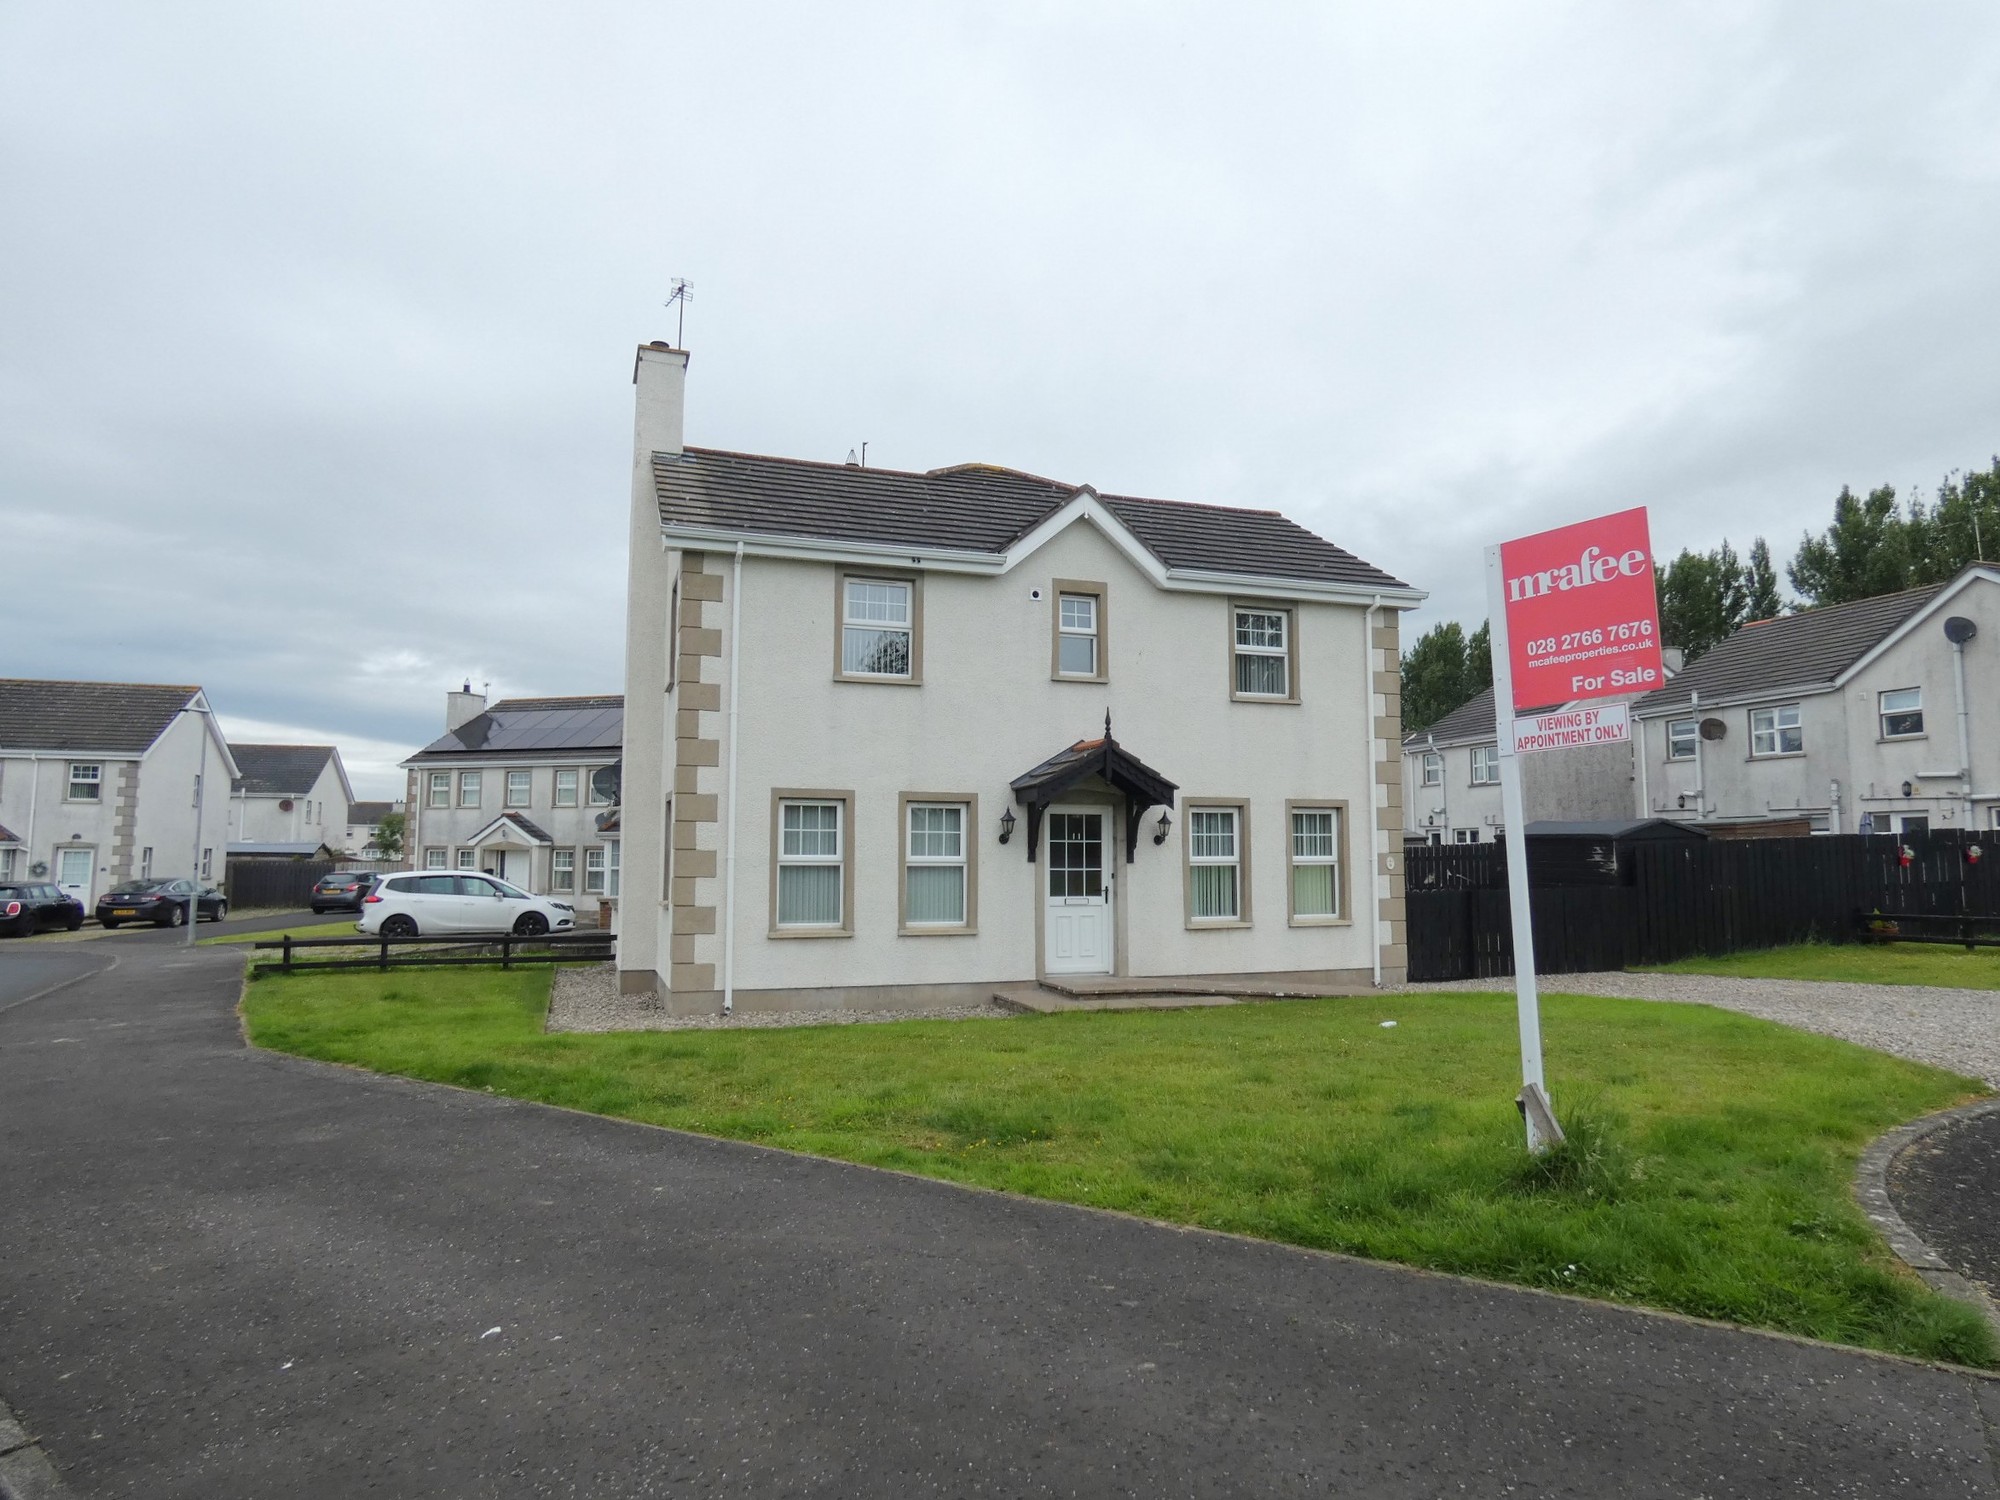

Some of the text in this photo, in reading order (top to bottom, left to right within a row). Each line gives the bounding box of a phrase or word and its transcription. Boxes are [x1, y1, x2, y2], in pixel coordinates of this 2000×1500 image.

[1527, 620, 1652, 656] 028 2766 7676
[1528, 638, 1653, 668] mcafeeproperties.co.uk
[1572, 666, 1656, 692] For Sale
[1536, 711, 1600, 732] VIEWING BY
[1517, 724, 1624, 750] APPOINTMENT ONLY
